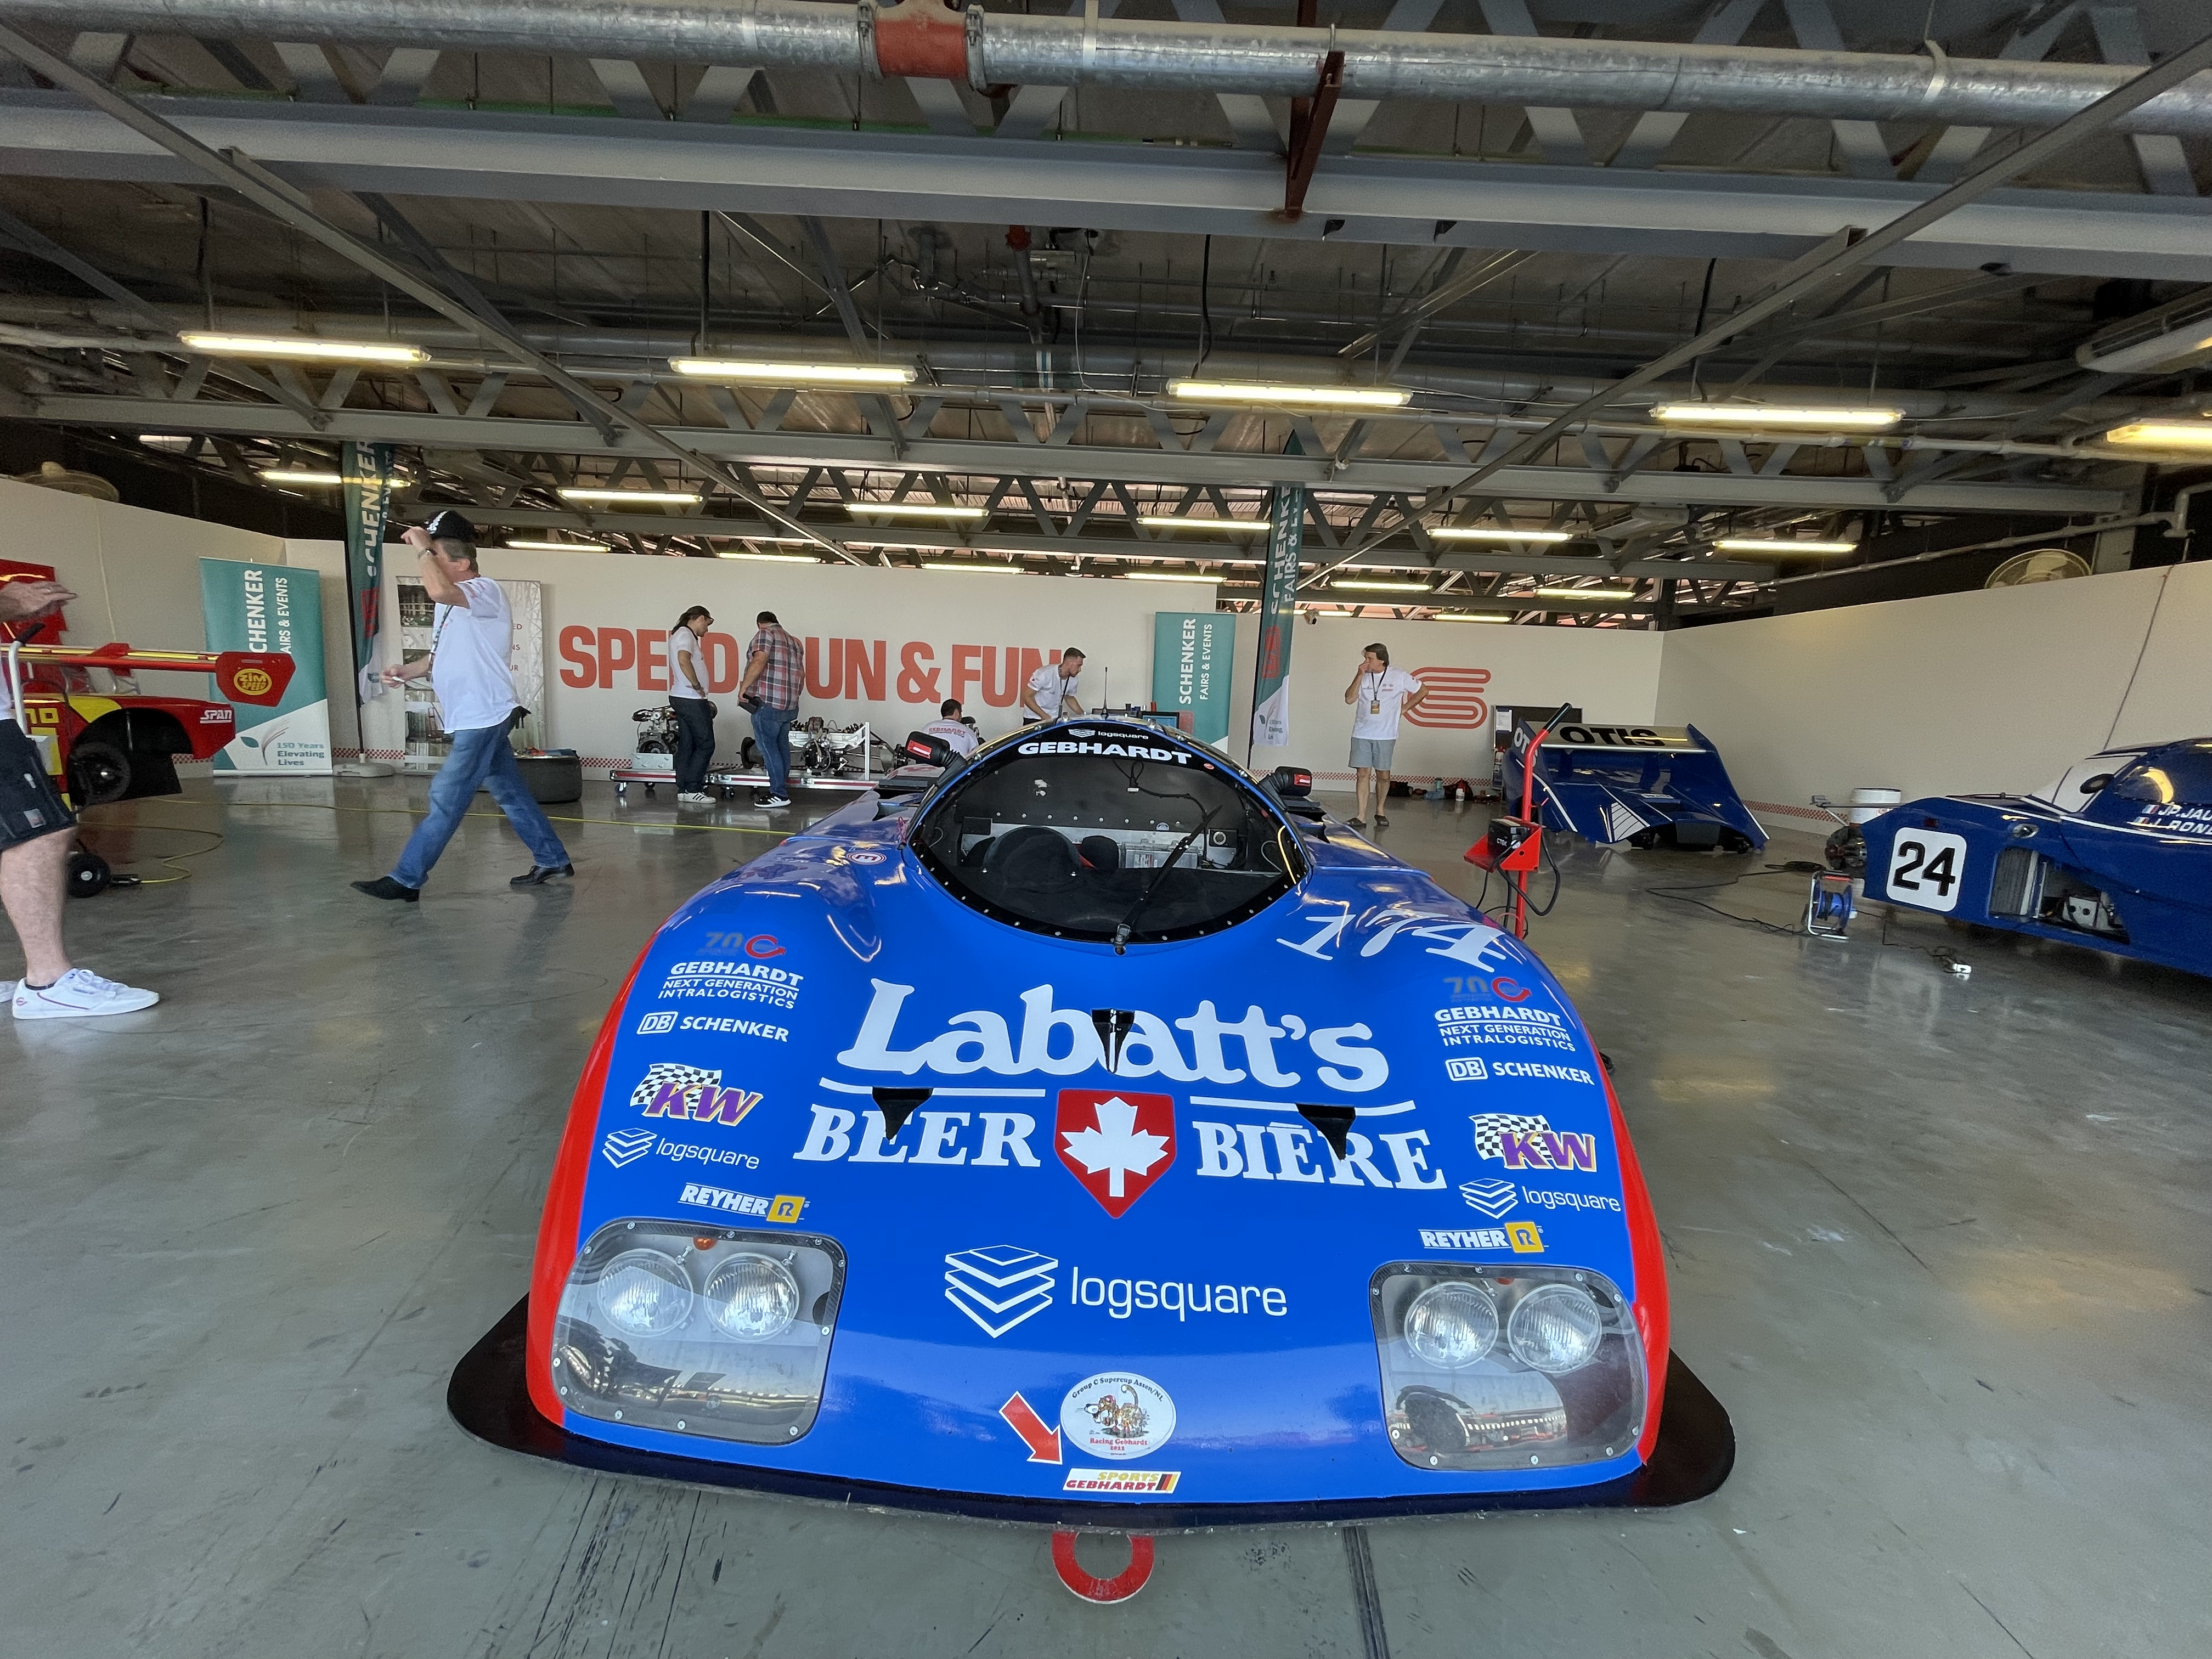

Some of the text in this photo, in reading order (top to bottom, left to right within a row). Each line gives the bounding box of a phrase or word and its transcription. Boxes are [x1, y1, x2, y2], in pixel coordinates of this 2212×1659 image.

[275, 577, 290, 617] EVENTS
[244, 570, 268, 653] CHENKER
[279, 630, 292, 654] AIRS
[1202, 624, 1212, 660] EVENTS
[560, 625, 738, 693] SPED
[896, 641, 941, 703] &
[1179, 618, 1197, 704] SCHENKER
[1200, 673, 1209, 700] FAIRS
[1098, 731, 1149, 740] logsquare
[1560, 726, 1666, 747] OTIS
[1018, 742, 1192, 764] GEBHARDT
[1892, 841, 1956, 896] 24
[1276, 910, 1506, 973] 174
[670, 961, 804, 986] GEBHARDT
[658, 988, 794, 1009] INTRALOGISTICS
[663, 979, 798, 1000] NEXT GENERATION
[1435, 1006, 1560, 1026] GEBHARDT
[644, 1016, 789, 1042] DB SCHENKER
[1440, 1024, 1571, 1042] NEXT GENERATION
[1444, 1035, 1576, 1052] INTRALOGISTICS
[1451, 1061, 1594, 1085] DB SCHENKER
[641, 1082, 764, 1126] KW
[656, 1138, 760, 1170] logsquare
[1500, 1131, 1597, 1172] KW
[680, 1186, 770, 1215] REYHER
[1522, 1186, 1621, 1212] logsquare
[1420, 1230, 1509, 1248] REYHER
[1071, 1267, 1288, 1322] logsquare
[1072, 1383, 1092, 1398] Group
[1133, 1379, 1164, 1402] Assen/NL
[1066, 1480, 1156, 1491] GEBHARDT
[1097, 1472, 1159, 1481] SPORTS
